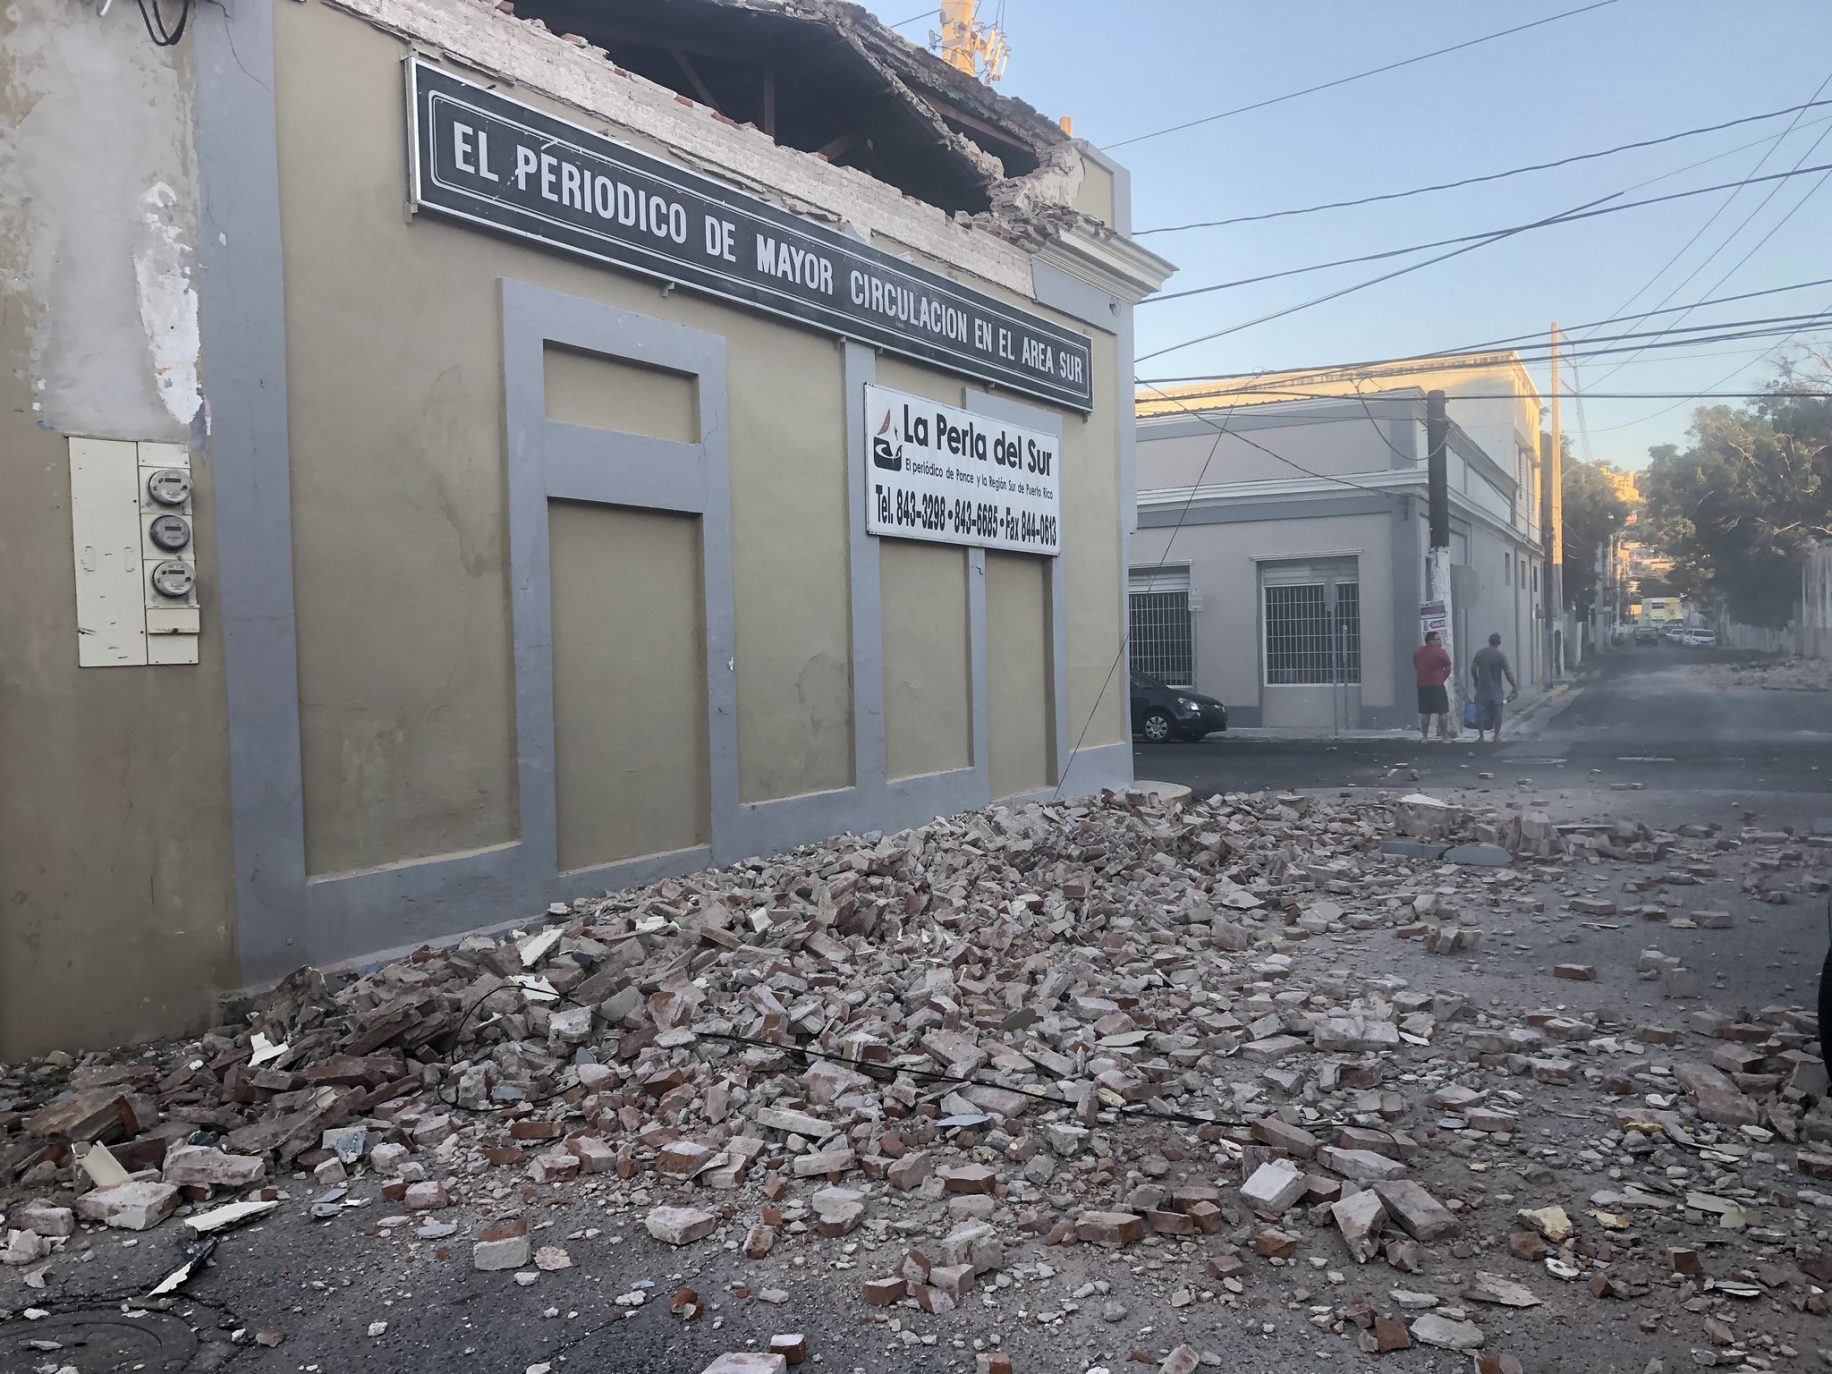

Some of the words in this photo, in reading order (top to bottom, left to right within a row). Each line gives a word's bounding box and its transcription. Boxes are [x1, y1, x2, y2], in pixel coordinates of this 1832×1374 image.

[453, 121, 499, 182] EL
[516, 144, 687, 244] PERIODICO
[705, 215, 737, 262] DE
[756, 233, 833, 295] MAYOR
[850, 270, 968, 344] CIRCULACION
[974, 317, 992, 352] EN
[999, 327, 1015, 361] EL
[1021, 336, 1054, 374] AREA
[1059, 351, 1083, 383] SUR
[903, 403, 929, 447] La
[936, 412, 987, 461] Perla
[993, 430, 1023, 470] del
[1027, 438, 1052, 476] Sur
[905, 457, 911, 471] El
[912, 460, 944, 478] periódico
[945, 466, 954, 480] de
[956, 468, 974, 484] Ponce
[976, 475, 981, 487] y
[981, 474, 988, 487] la
[989, 475, 1007, 492] Región
[1008, 480, 1016, 492] Sur
[1017, 482, 1025, 494] de
[1026, 483, 1042, 497] Puerto
[1043, 486, 1054, 500] Rico
[875, 483, 893, 524] Tel.
[896, 488, 946, 532] 843-3298
[954, 498, 998, 538] 843-6685
[1005, 506, 1020, 541] Fax
[1021, 510, 1057, 546] 844-0613
